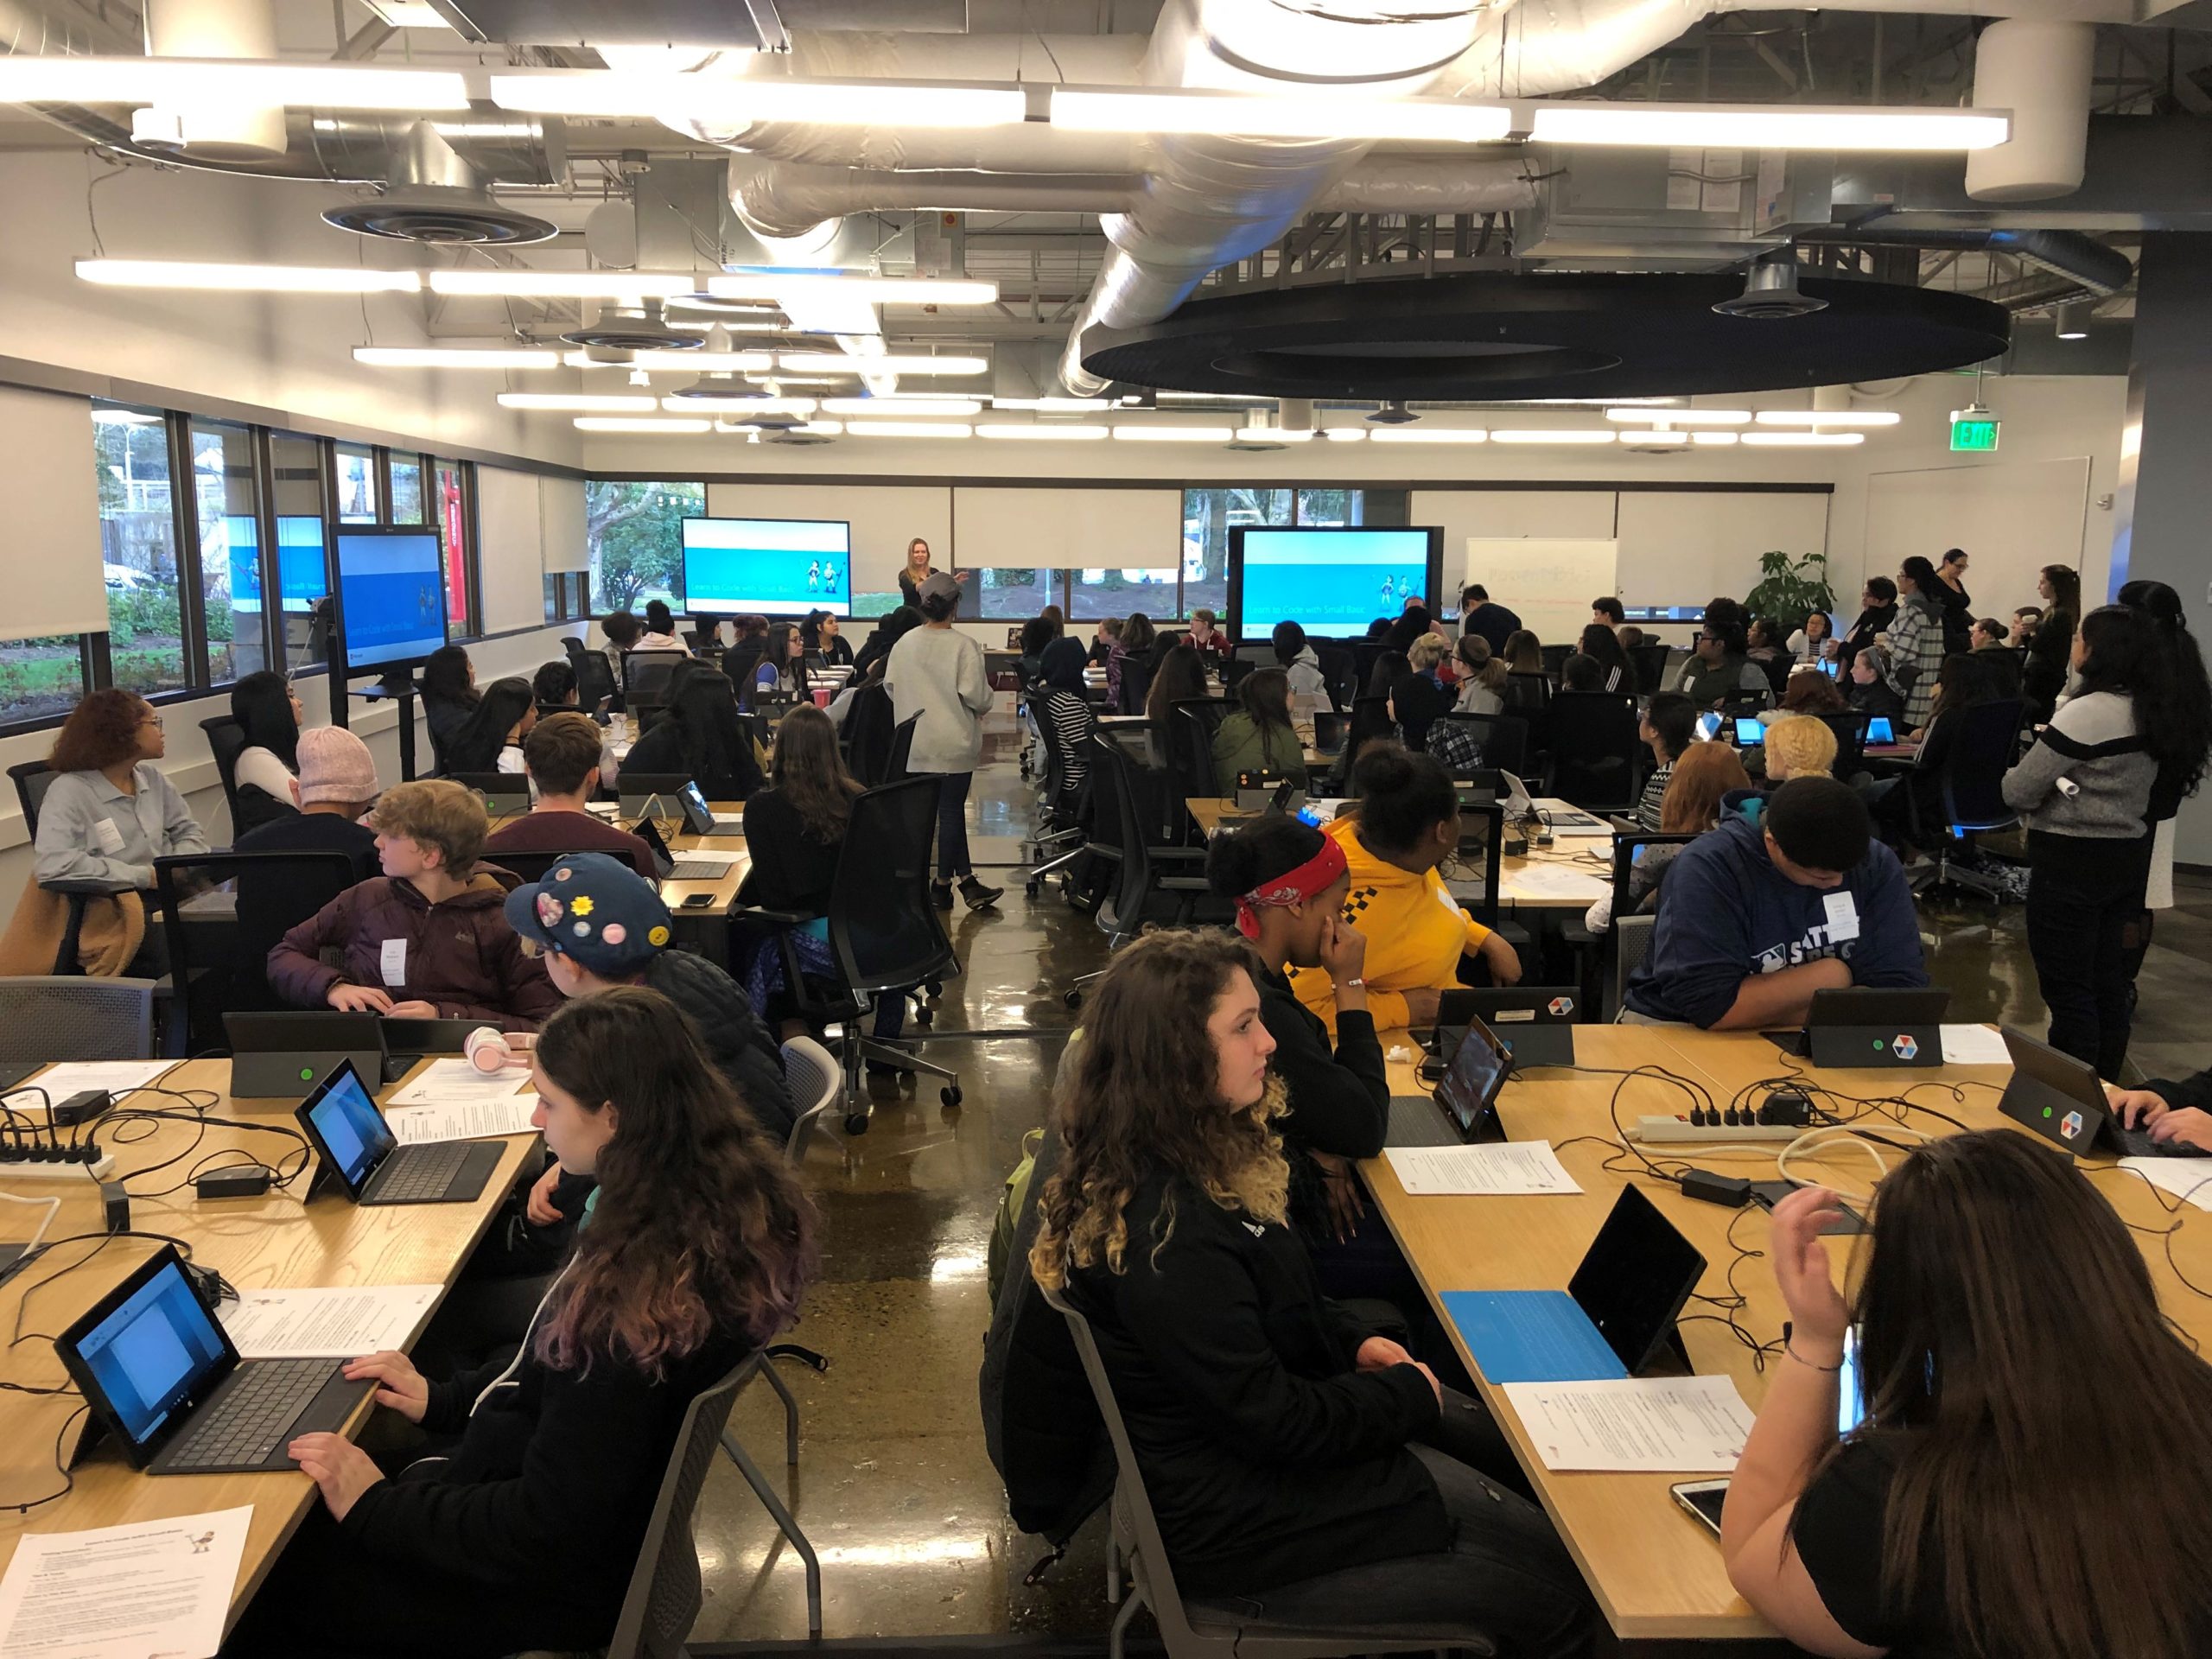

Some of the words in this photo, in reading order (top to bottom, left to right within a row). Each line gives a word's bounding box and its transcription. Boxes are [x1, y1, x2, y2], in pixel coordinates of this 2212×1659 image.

[1960, 423, 1993, 447] EXIT
[1249, 605, 1270, 614] Learn
[1282, 605, 1304, 614] Code
[1306, 605, 1322, 614] with
[1324, 605, 1344, 614] Small
[1346, 605, 1366, 614] Basic
